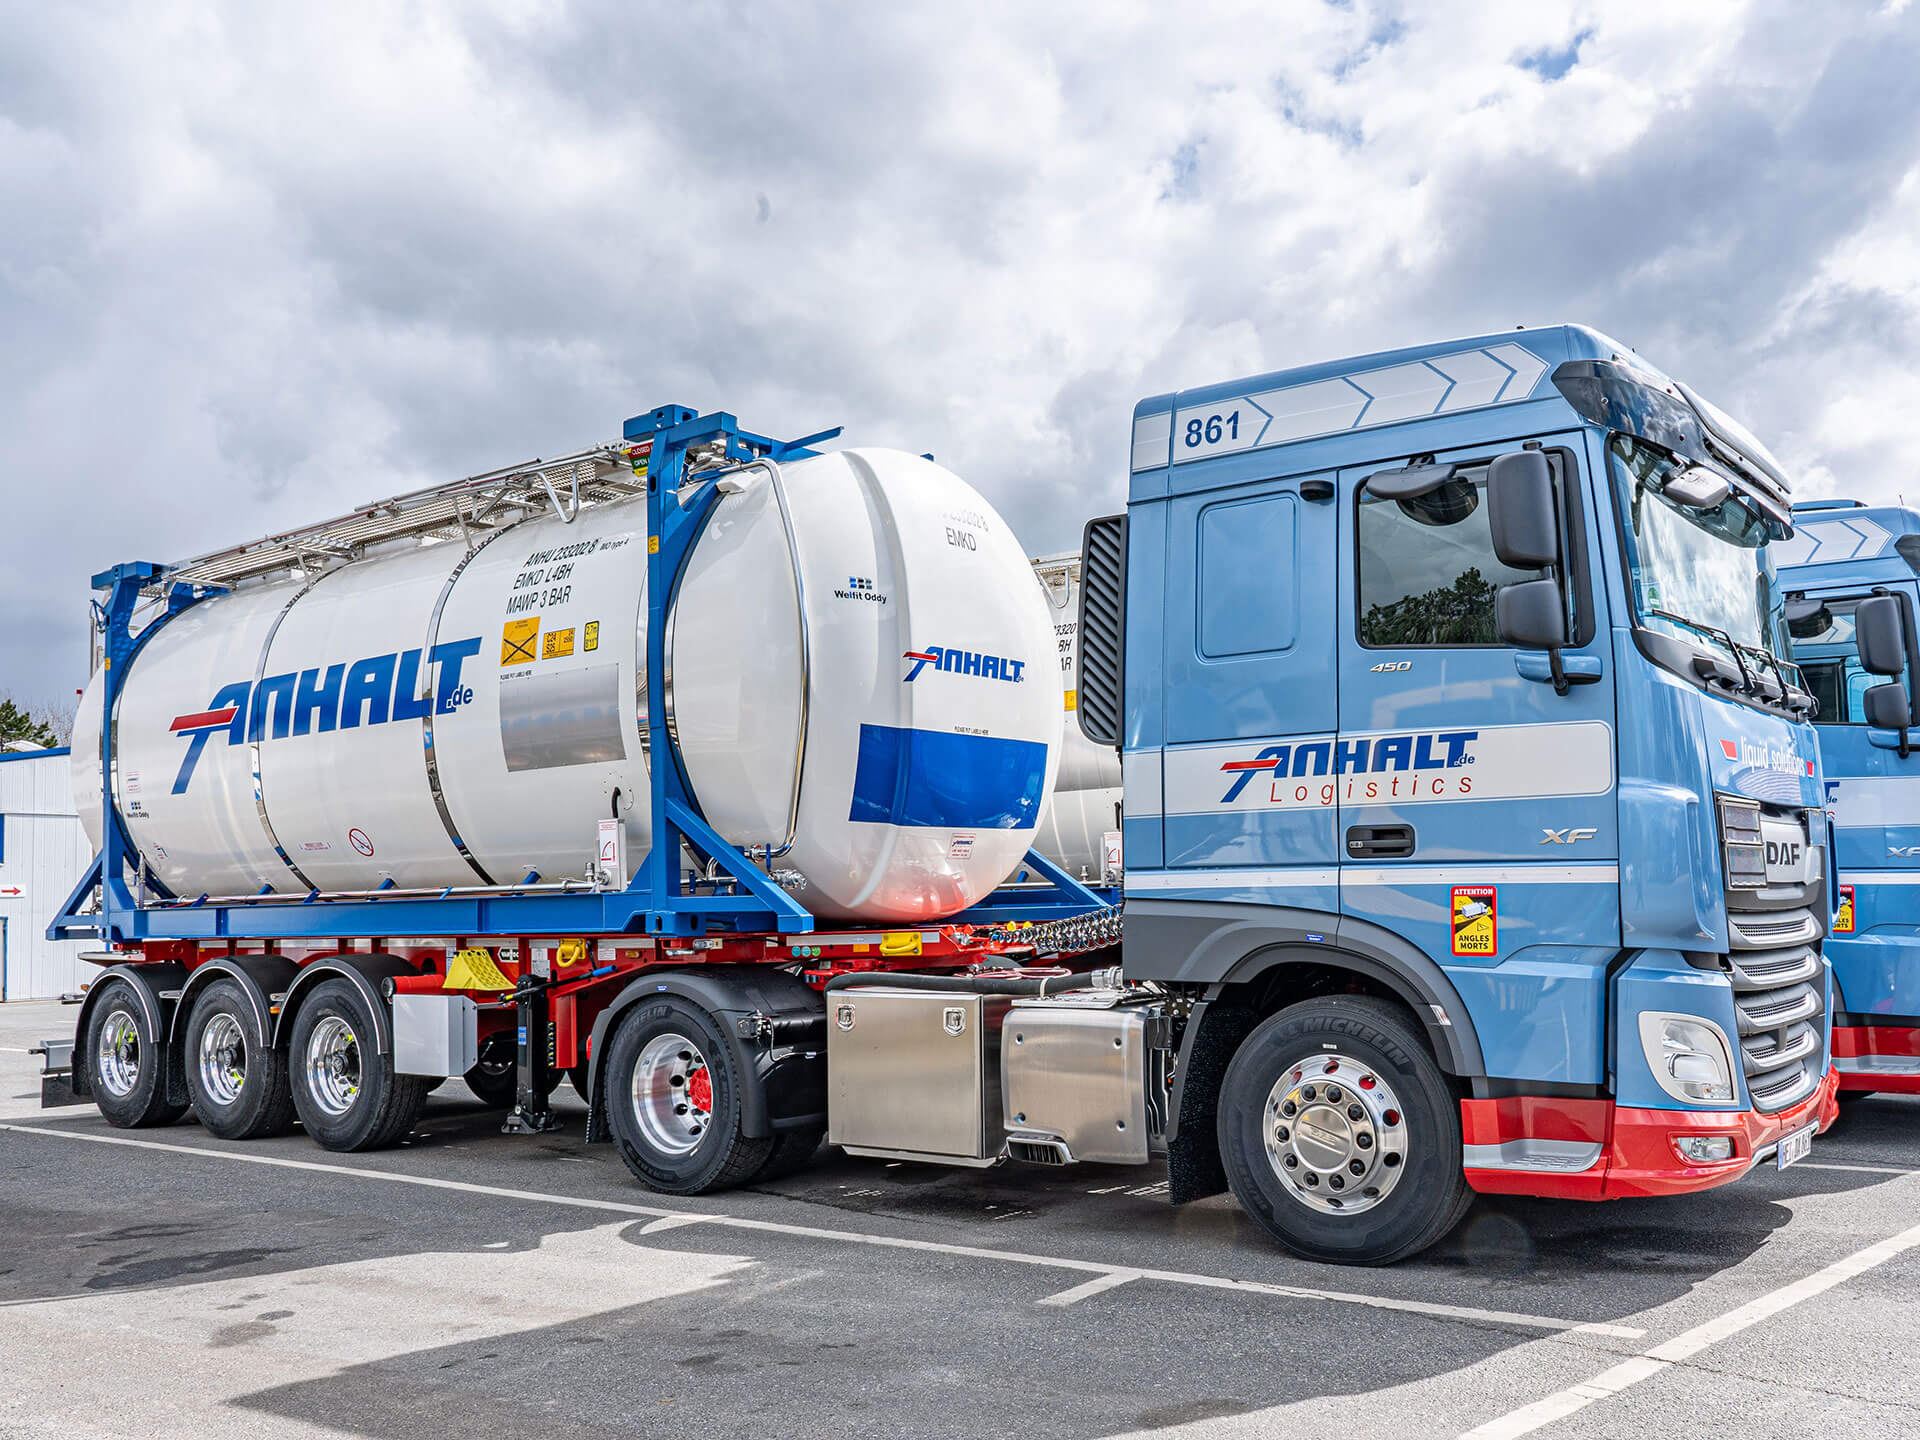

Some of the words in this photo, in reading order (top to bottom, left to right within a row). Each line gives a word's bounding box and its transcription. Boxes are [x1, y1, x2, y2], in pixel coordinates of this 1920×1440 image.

[1185, 410, 1239, 448] 861
[632, 446, 650, 456] CLOSED
[945, 527, 977, 551] EMKD
[522, 548, 554, 568] ANHU
[551, 541, 591, 562] 233202
[513, 568, 545, 590] EMKD
[545, 562, 575, 583] L4BH
[506, 592, 539, 615] MAWP
[540, 590, 548, 608] 3
[549, 585, 572, 606] BAR
[864, 592, 887, 604] Oddy
[1370, 661, 1412, 672] 450
[1741, 735, 1769, 773] liquid
[1270, 774, 1474, 805] Logistics
[1539, 828, 1598, 845] XF
[1766, 841, 1801, 866] DAF
[1454, 888, 1494, 896] ATTENTION
[1303, 1016, 1411, 1066] MICHELIN
